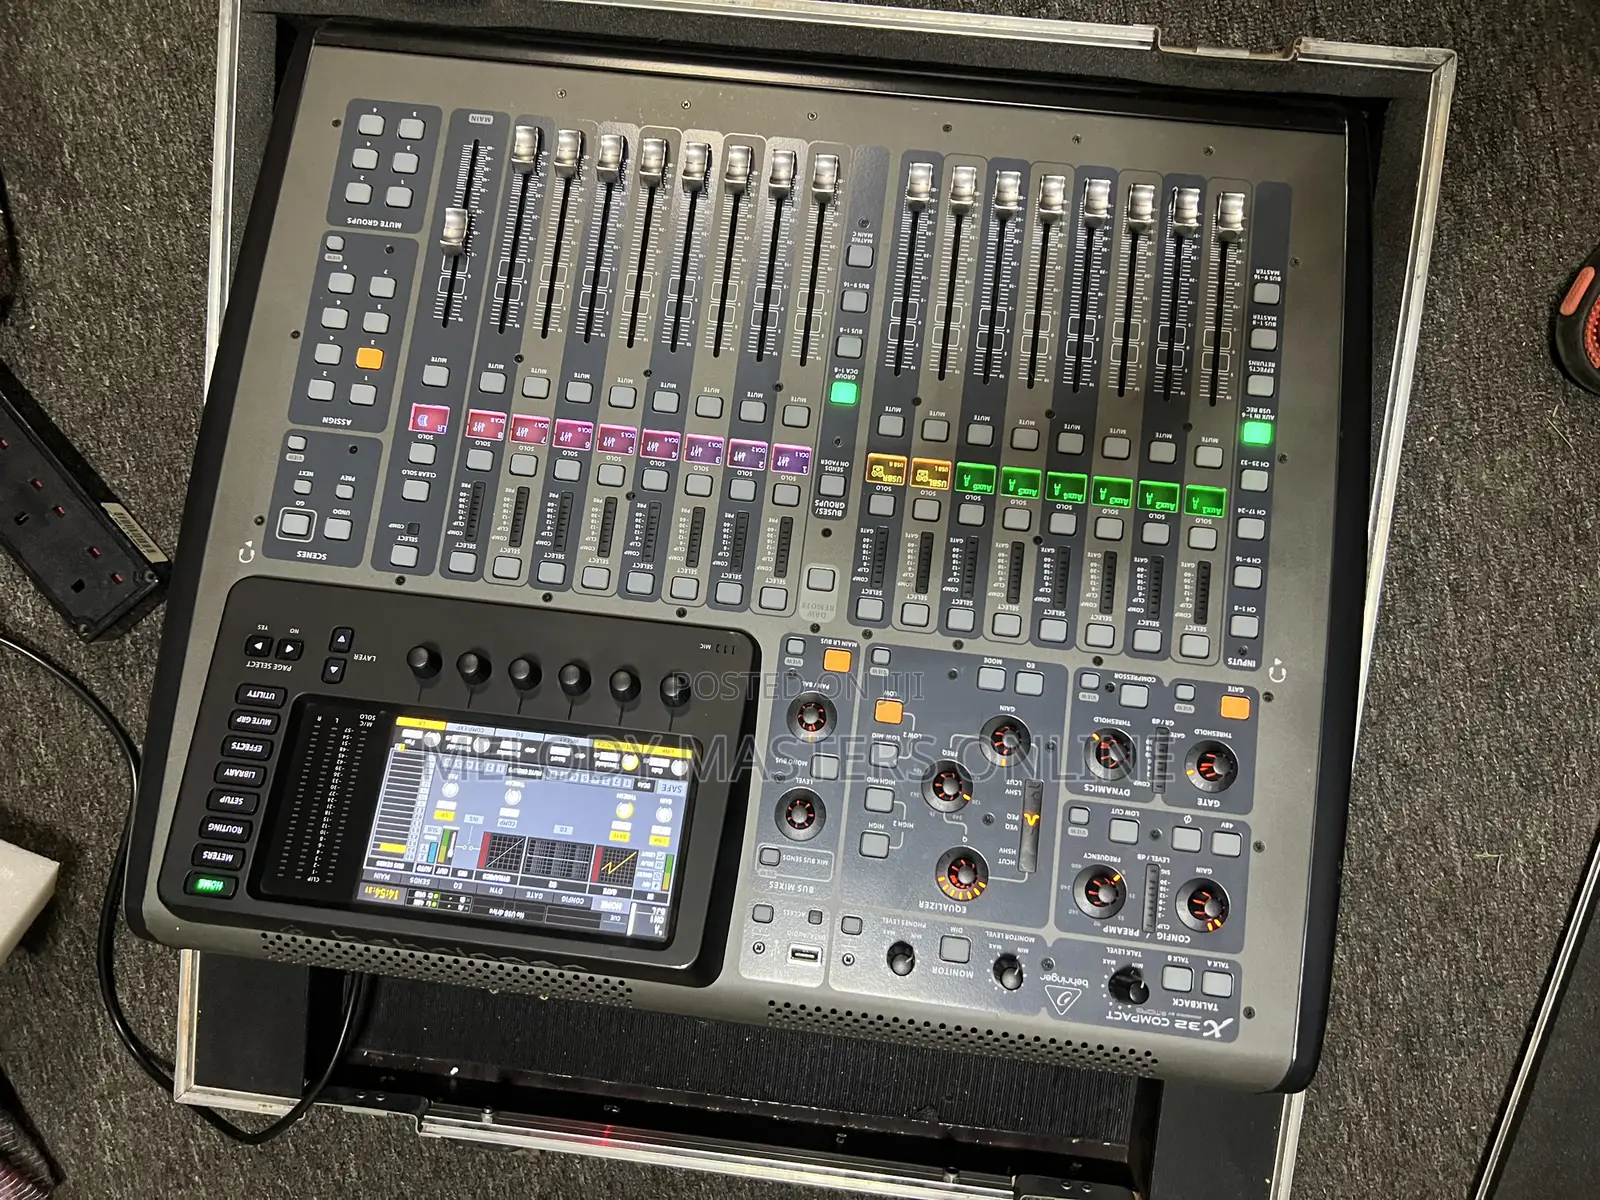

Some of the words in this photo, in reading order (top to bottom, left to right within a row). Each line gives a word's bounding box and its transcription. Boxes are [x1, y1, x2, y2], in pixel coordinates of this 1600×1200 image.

[470, 114, 492, 123] MAIN
[346, 217, 379, 227] GROUPS
[380, 220, 402, 229] MUTE
[858, 231, 873, 239] MAIN
[851, 236, 873, 244] MATRIX
[1255, 268, 1280, 276] MASTER
[322, 416, 352, 426] ASSIGN
[437, 424, 447, 433] LR
[401, 469, 419, 477] SOLO
[340, 474, 356, 482] PREV
[928, 477, 947, 488] USBL
[814, 499, 845, 509] GROUPS
[1109, 497, 1129, 506] Aux3
[1155, 501, 1175, 510] Aux2
[815, 507, 842, 517] BUSES/
[1202, 506, 1221, 515] Aux1
[296, 550, 327, 560] SCENES
[801, 601, 834, 612] REMOTE
[807, 610, 827, 619] DAW
[1184, 624, 1207, 632] SELECT
[353, 653, 376, 662] LAYER
[983, 657, 1002, 665] MODE
[1227, 657, 1256, 667] INPUTS
[246, 660, 272, 670] SELECT
[274, 662, 292, 672] PAGE
[1026, 661, 1035, 669] EQ
[1114, 672, 1156, 683] COMPRESSOR
[883, 689, 897, 697] LOW
[1228, 685, 1244, 693] GATE
[247, 690, 276, 700] UTILITY
[236, 715, 254, 724] GRP
[254, 717, 272, 726] MUTE
[359, 713, 376, 721] SOLO
[1093, 716, 1131, 726] THRESHOLD
[1194, 728, 1232, 739] THRESHOLD
[231, 742, 263, 752] EFFECTS
[942, 749, 958, 757] FREQ
[224, 768, 256, 779] LIBRARY
[867, 776, 879, 784] MID
[662, 784, 682, 793] SAFE
[1084, 783, 1131, 797] DYNAMICS
[220, 796, 244, 805] SETUP
[1197, 798, 1220, 807] GATE
[1110, 807, 1124, 815] CUT
[1125, 809, 1140, 817] LOW
[208, 822, 243, 834] ROUTING
[899, 821, 914, 829] HIGH
[1005, 823, 1018, 831] VEQ
[1220, 821, 1234, 829] 48V
[202, 851, 233, 862] METERS
[783, 854, 803, 862] SENDS
[1083, 852, 1121, 863] FREQUENCY
[817, 858, 828, 866] MIX
[998, 858, 1016, 866] HCUT
[1196, 866, 1213, 875] GAIN
[374, 872, 391, 880] MAIN
[197, 879, 223, 891] HOME
[409, 877, 431, 886] SENDS
[769, 880, 792, 891] MIXES
[489, 887, 503, 895] DYN
[794, 883, 814, 894] BUS
[918, 900, 967, 914] EQUALIZER
[882, 917, 901, 925] LEVEL
[902, 919, 927, 928] PHONES
[950, 926, 963, 934] DIM
[1103, 925, 1140, 937] PREAMP
[985, 930, 1005, 940] LEVEL
[1006, 932, 1035, 943] MONITOR
[1156, 932, 1191, 943] CONFIG
[1106, 947, 1125, 955] LEVEL
[1126, 949, 1142, 957] TALK
[1214, 961, 1229, 969] TALK
[932, 966, 974, 978] MONITOR
[1040, 974, 1089, 988] behringer
[1172, 998, 1218, 1011] TALKBACK
[1106, 1010, 1170, 1027] COMPACT
